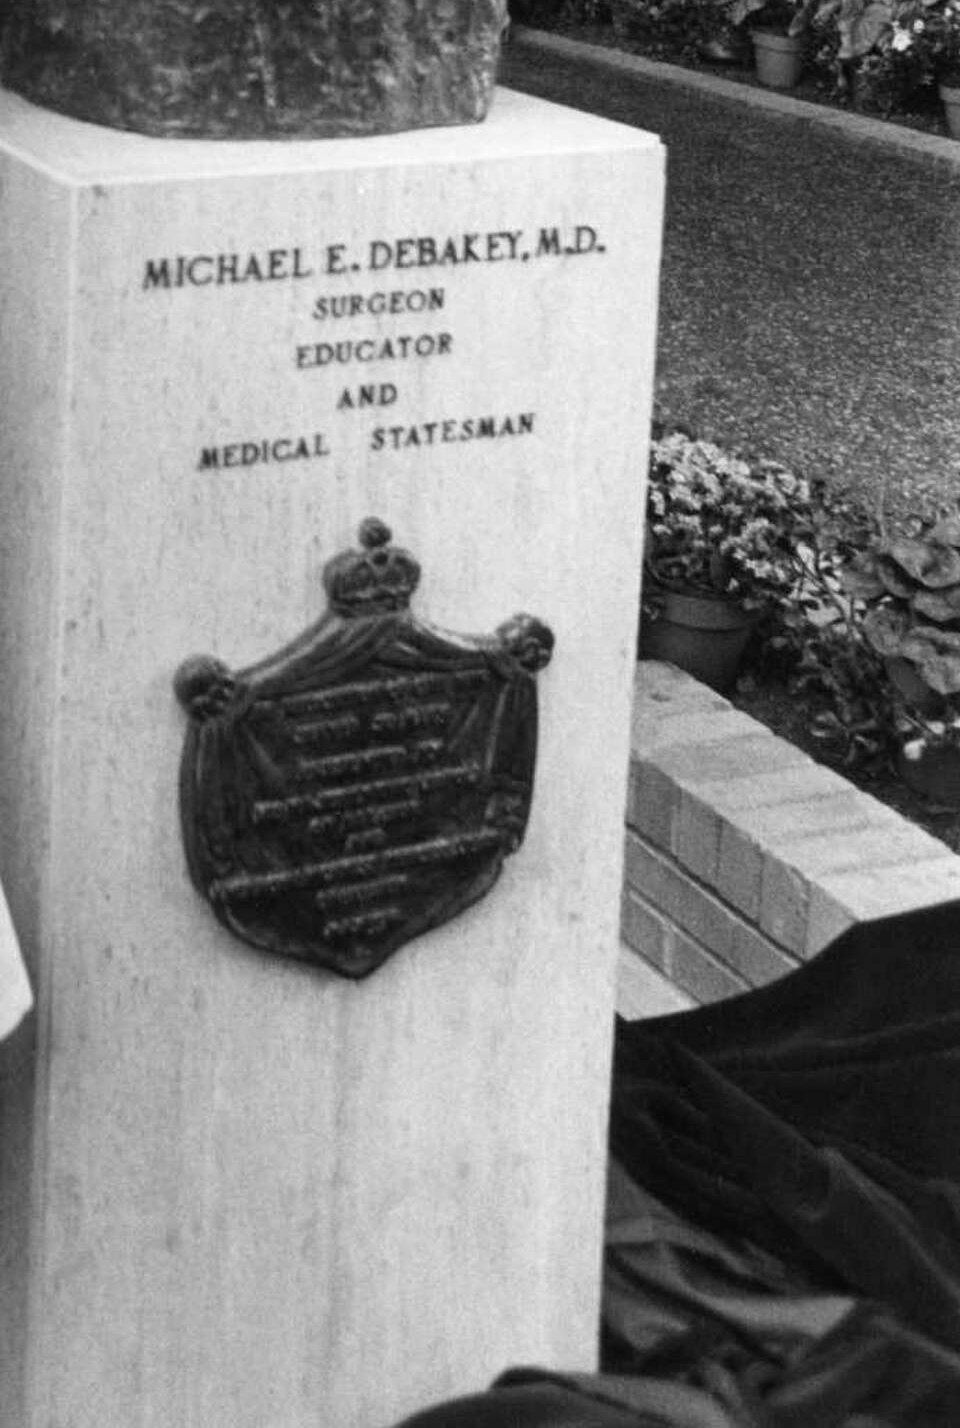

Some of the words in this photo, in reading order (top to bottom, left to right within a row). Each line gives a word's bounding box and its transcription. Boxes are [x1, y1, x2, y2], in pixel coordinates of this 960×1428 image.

[142, 249, 312, 290] MICHAEL
[326, 244, 361, 275] E.
[368, 229, 529, 271] DEBAKEY,
[536, 225, 607, 258] M.D.
[312, 288, 446, 320] SURGEON
[296, 332, 454, 369] EDUCATOR
[337, 383, 398, 410] AND
[197, 433, 330, 471] MEDICAL
[371, 412, 536, 451] STATESMAN
